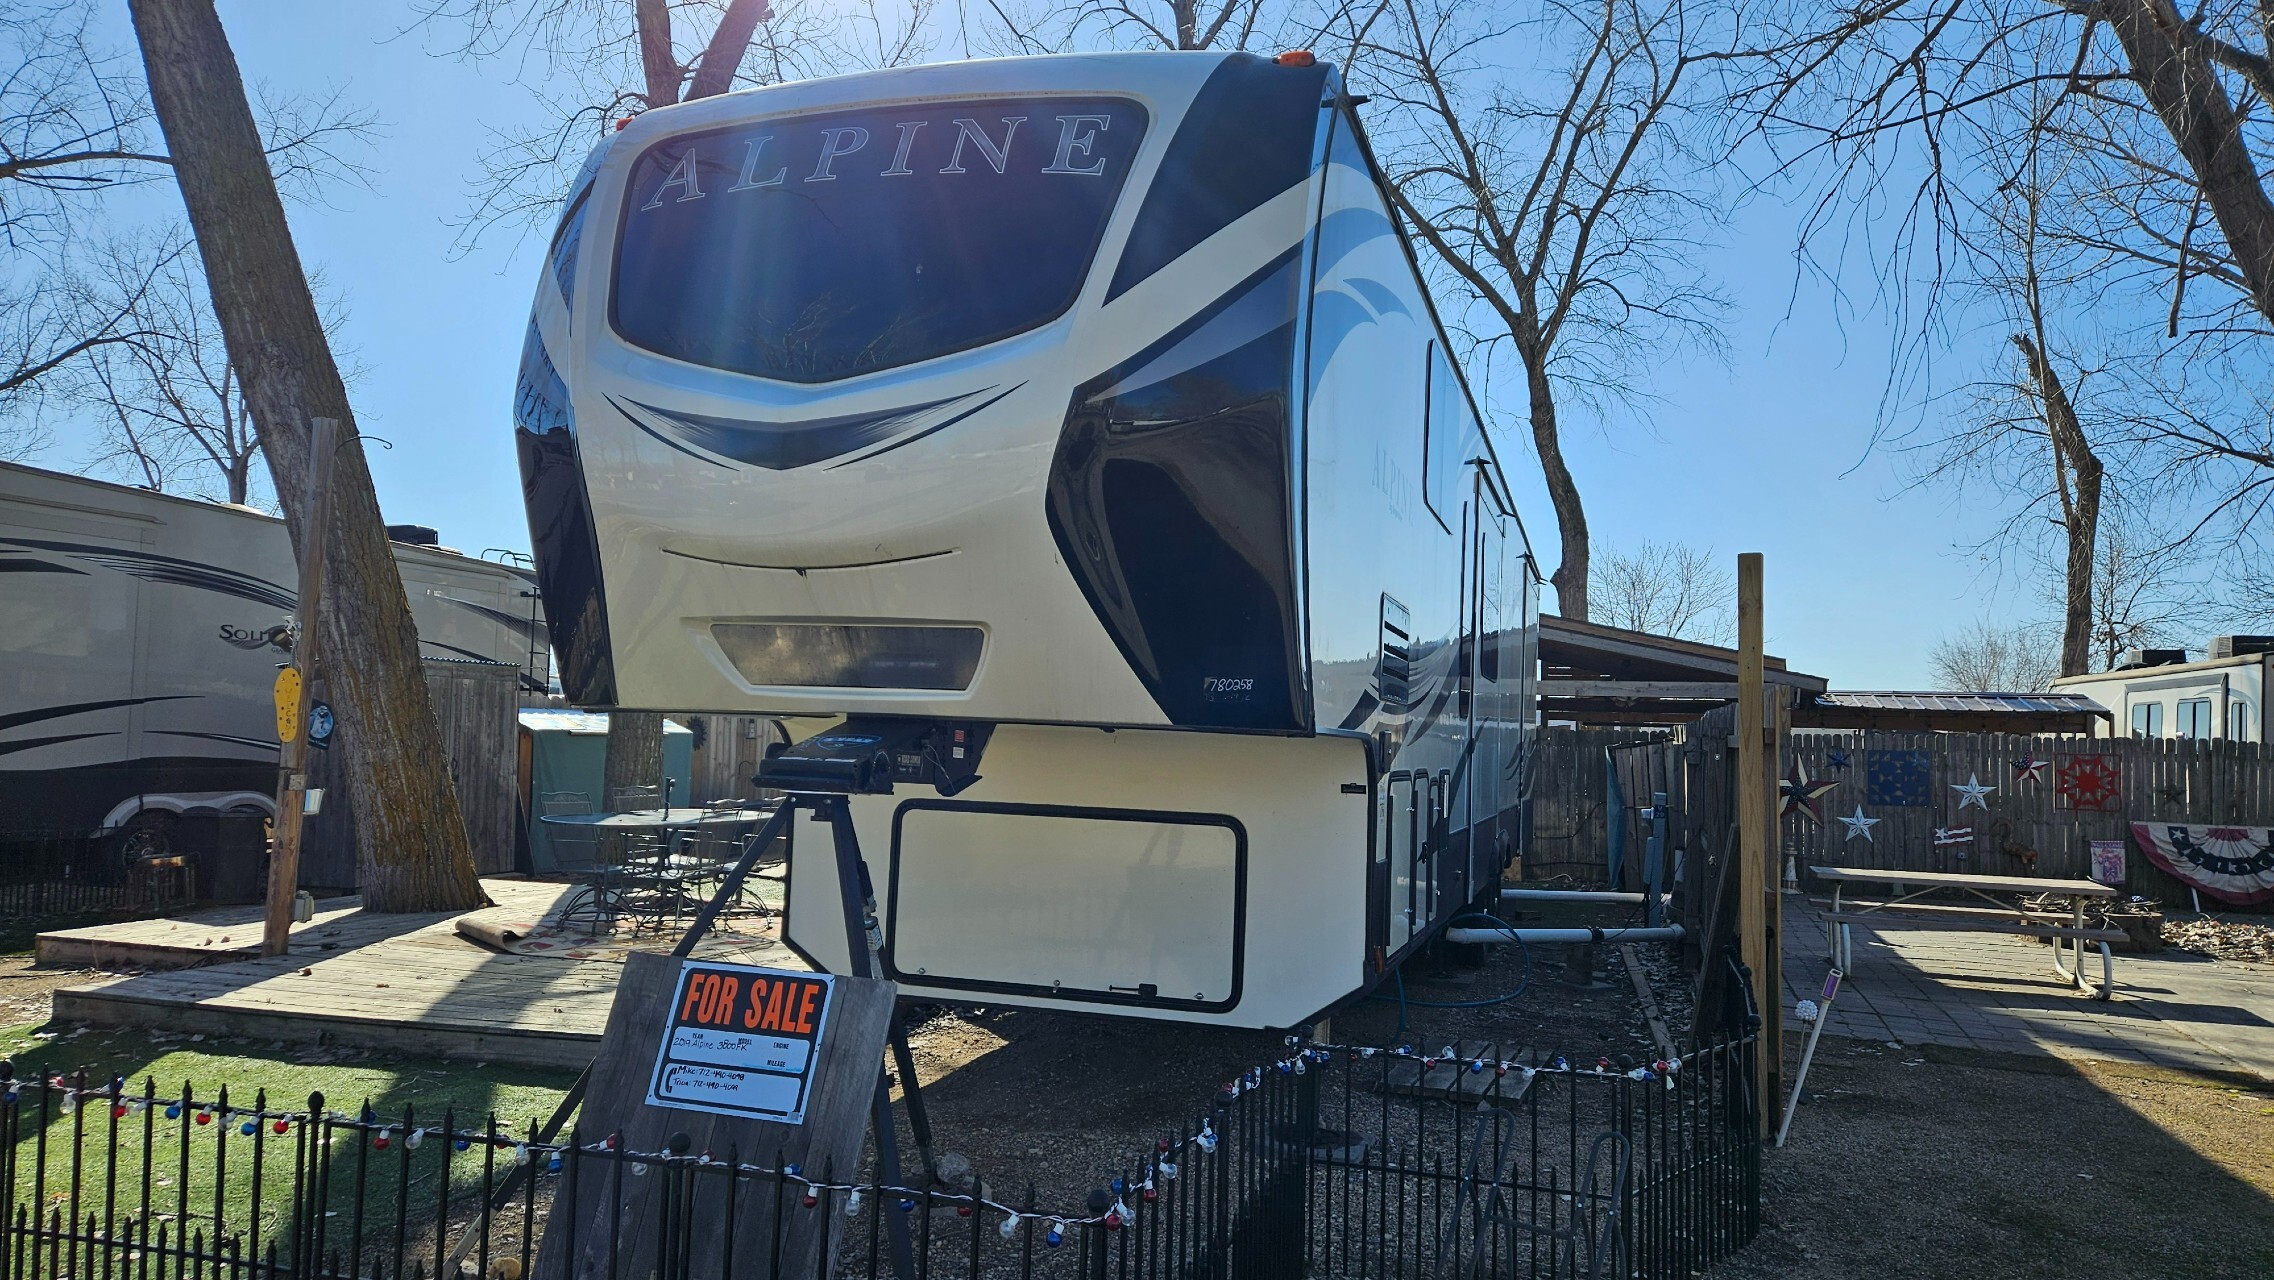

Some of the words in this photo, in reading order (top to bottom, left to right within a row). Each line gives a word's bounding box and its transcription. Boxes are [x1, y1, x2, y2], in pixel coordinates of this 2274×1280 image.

[641, 115, 1111, 211] ALPINE
[1209, 678, 1253, 691] 780258
[681, 973, 739, 1025] FOR
[744, 978, 820, 1034] SALE
[691, 1039, 714, 1050] Alpine
[766, 1059, 787, 1068] MILEAGE
